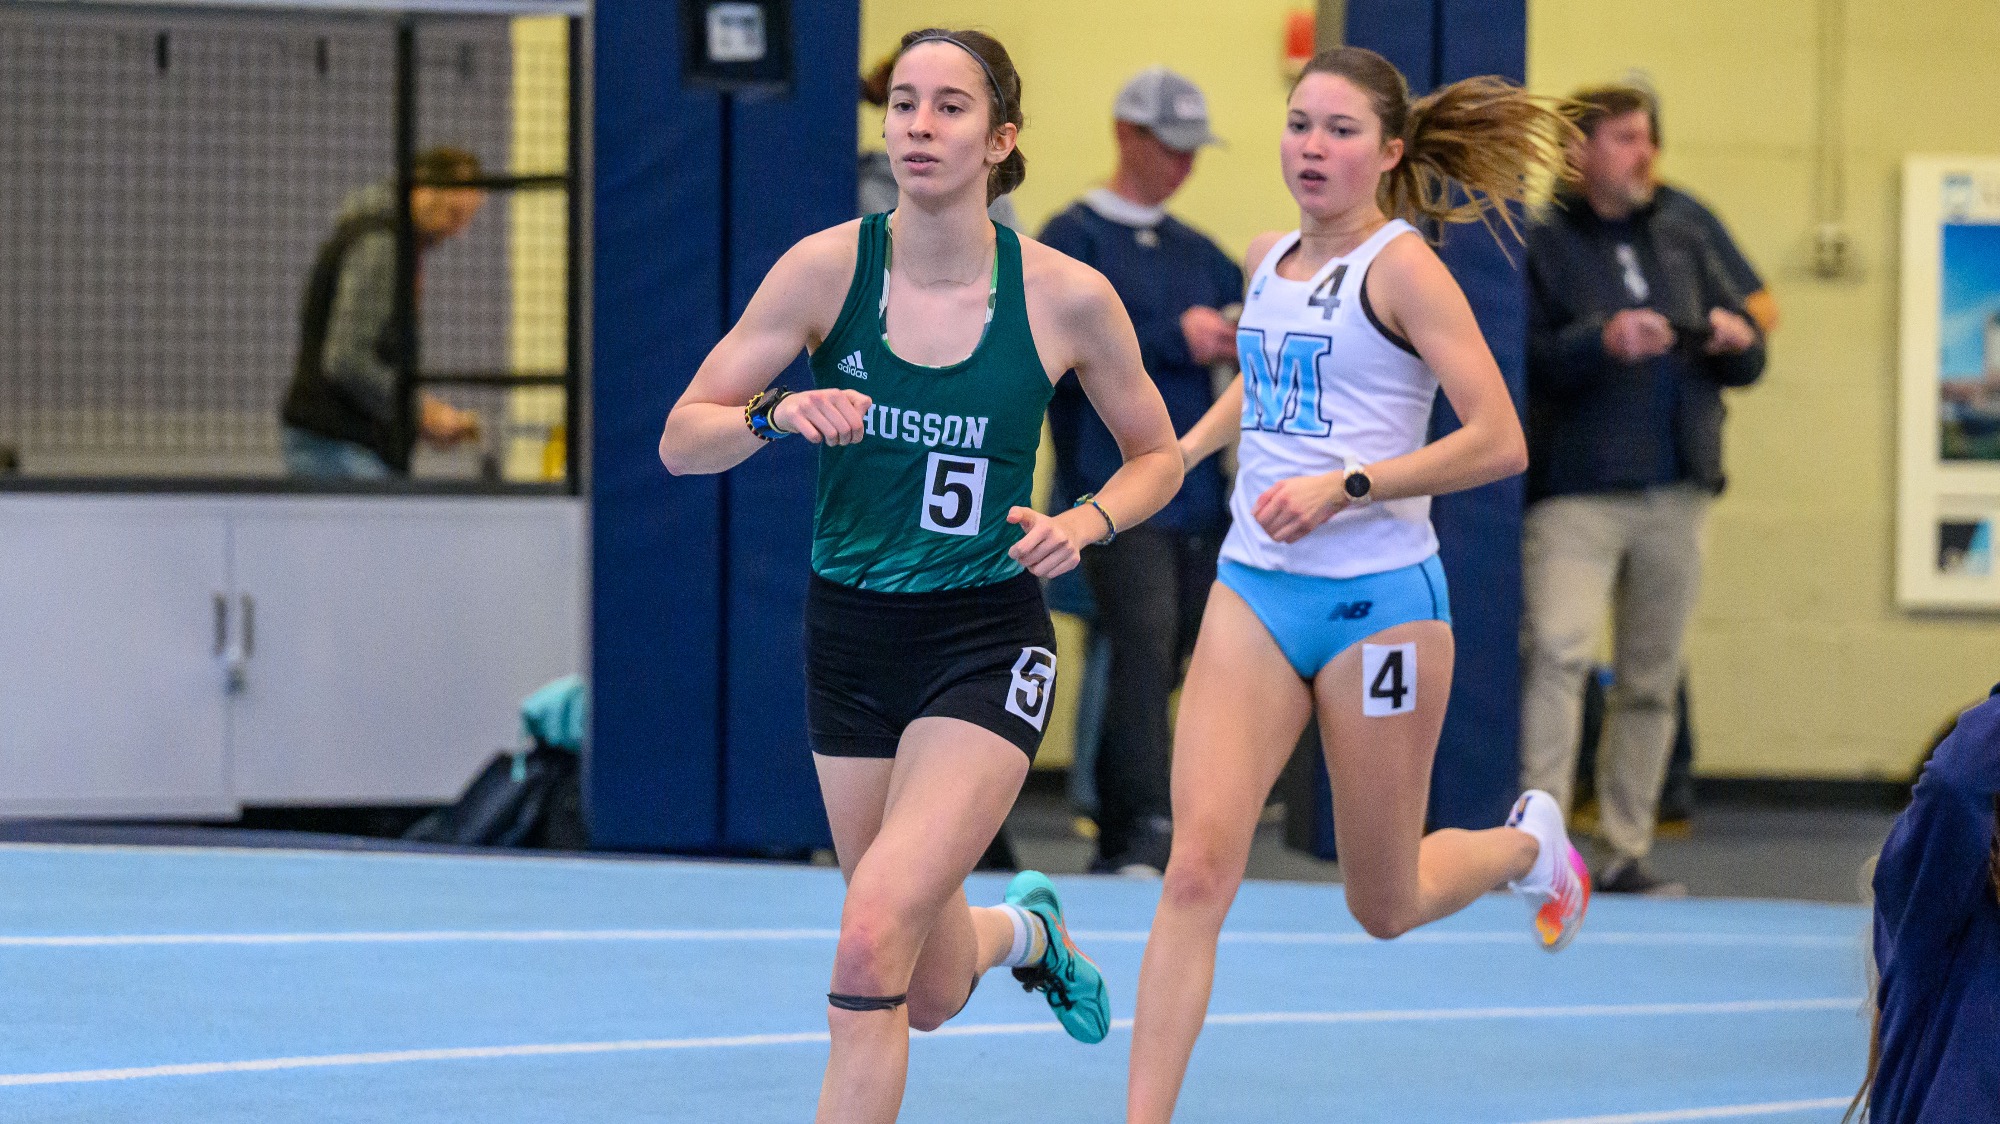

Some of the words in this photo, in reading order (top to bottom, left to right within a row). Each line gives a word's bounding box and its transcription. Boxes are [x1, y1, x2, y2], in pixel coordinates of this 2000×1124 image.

[1308, 264, 1349, 321] 4
[837, 362, 869, 380] adidas
[1236, 327, 1332, 438] M
[928, 459, 976, 528] 5
[1328, 601, 1374, 621] NB
[1015, 649, 1052, 718] 5
[1369, 650, 1408, 709] 4
